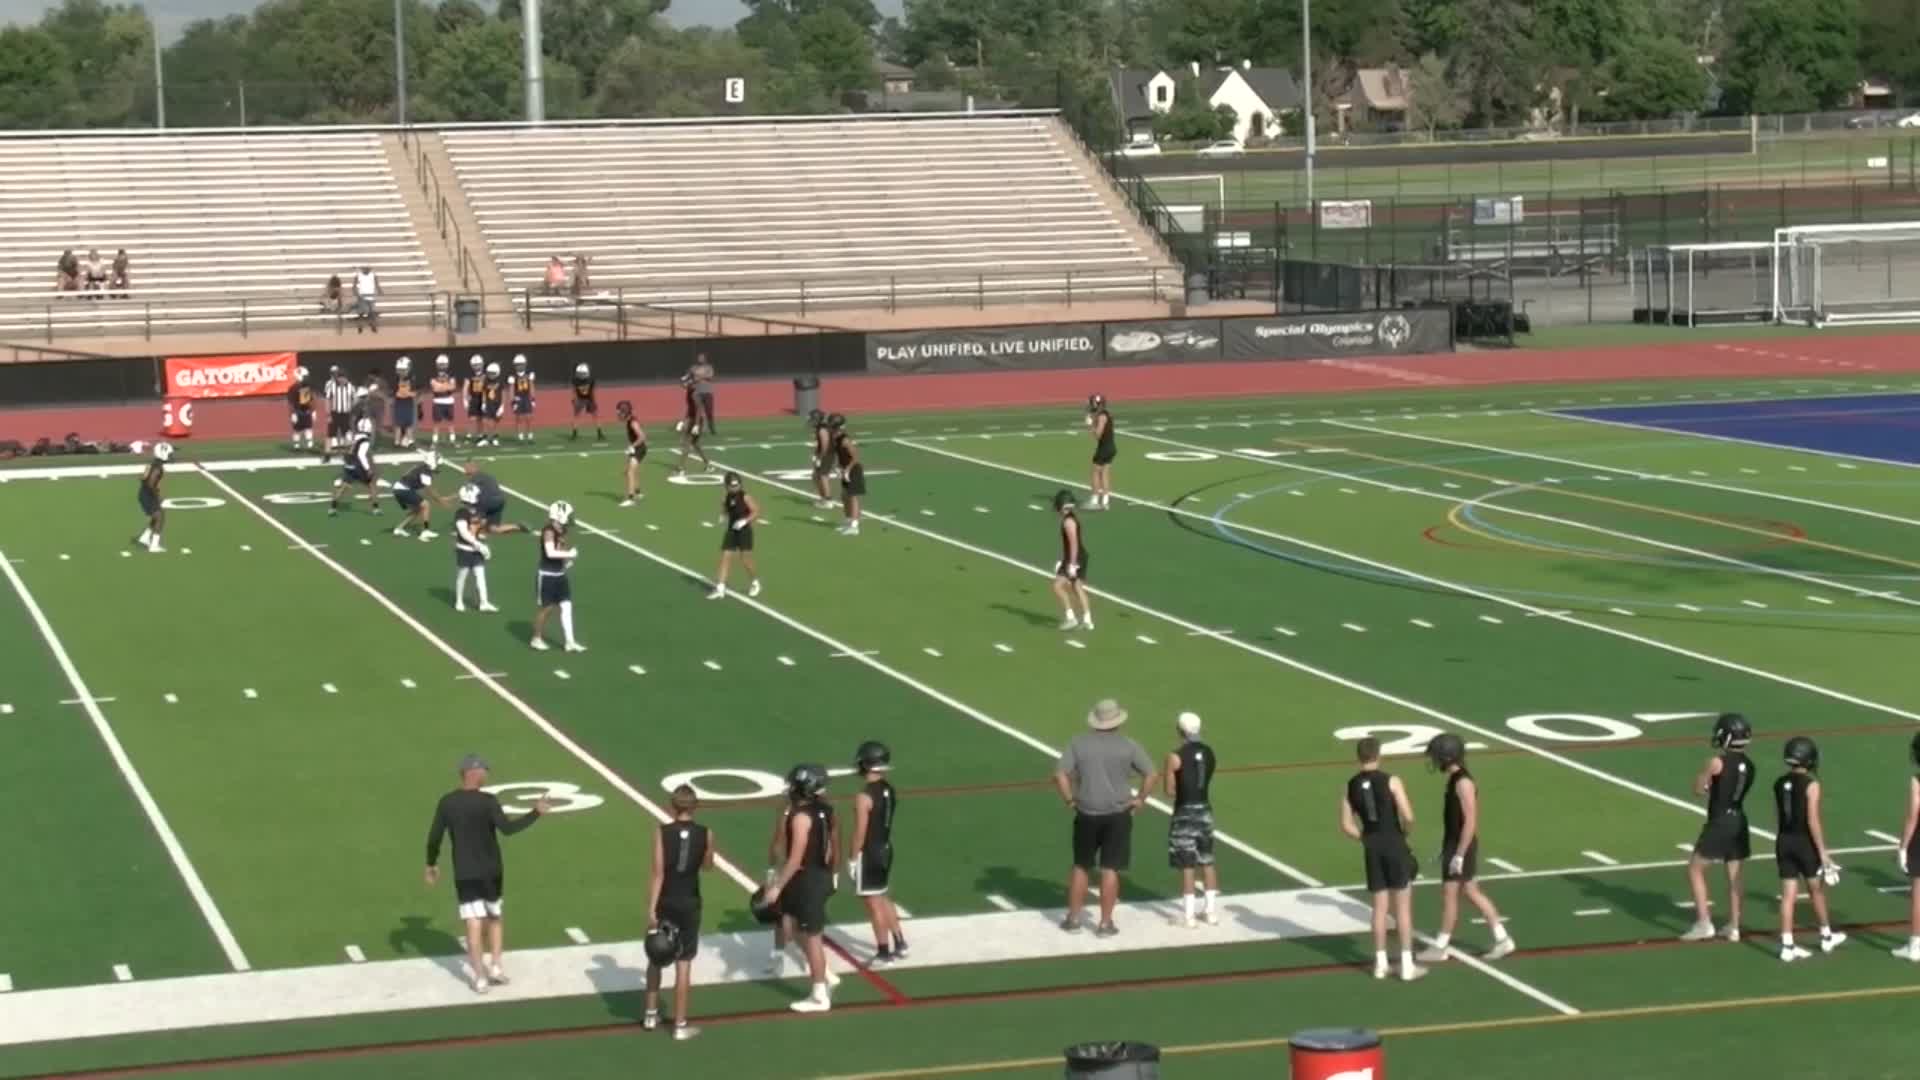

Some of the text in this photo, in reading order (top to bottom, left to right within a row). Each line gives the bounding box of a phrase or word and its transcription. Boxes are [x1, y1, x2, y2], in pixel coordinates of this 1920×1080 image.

[1256, 322, 1374, 338] Special Olympics
[877, 346, 916, 360] PLAY
[920, 342, 987, 358] UNIFIED.
[990, 341, 1024, 354] LIVE
[1028, 337, 1094, 352] UNIFIED.
[176, 363, 288, 386] GATORADE
